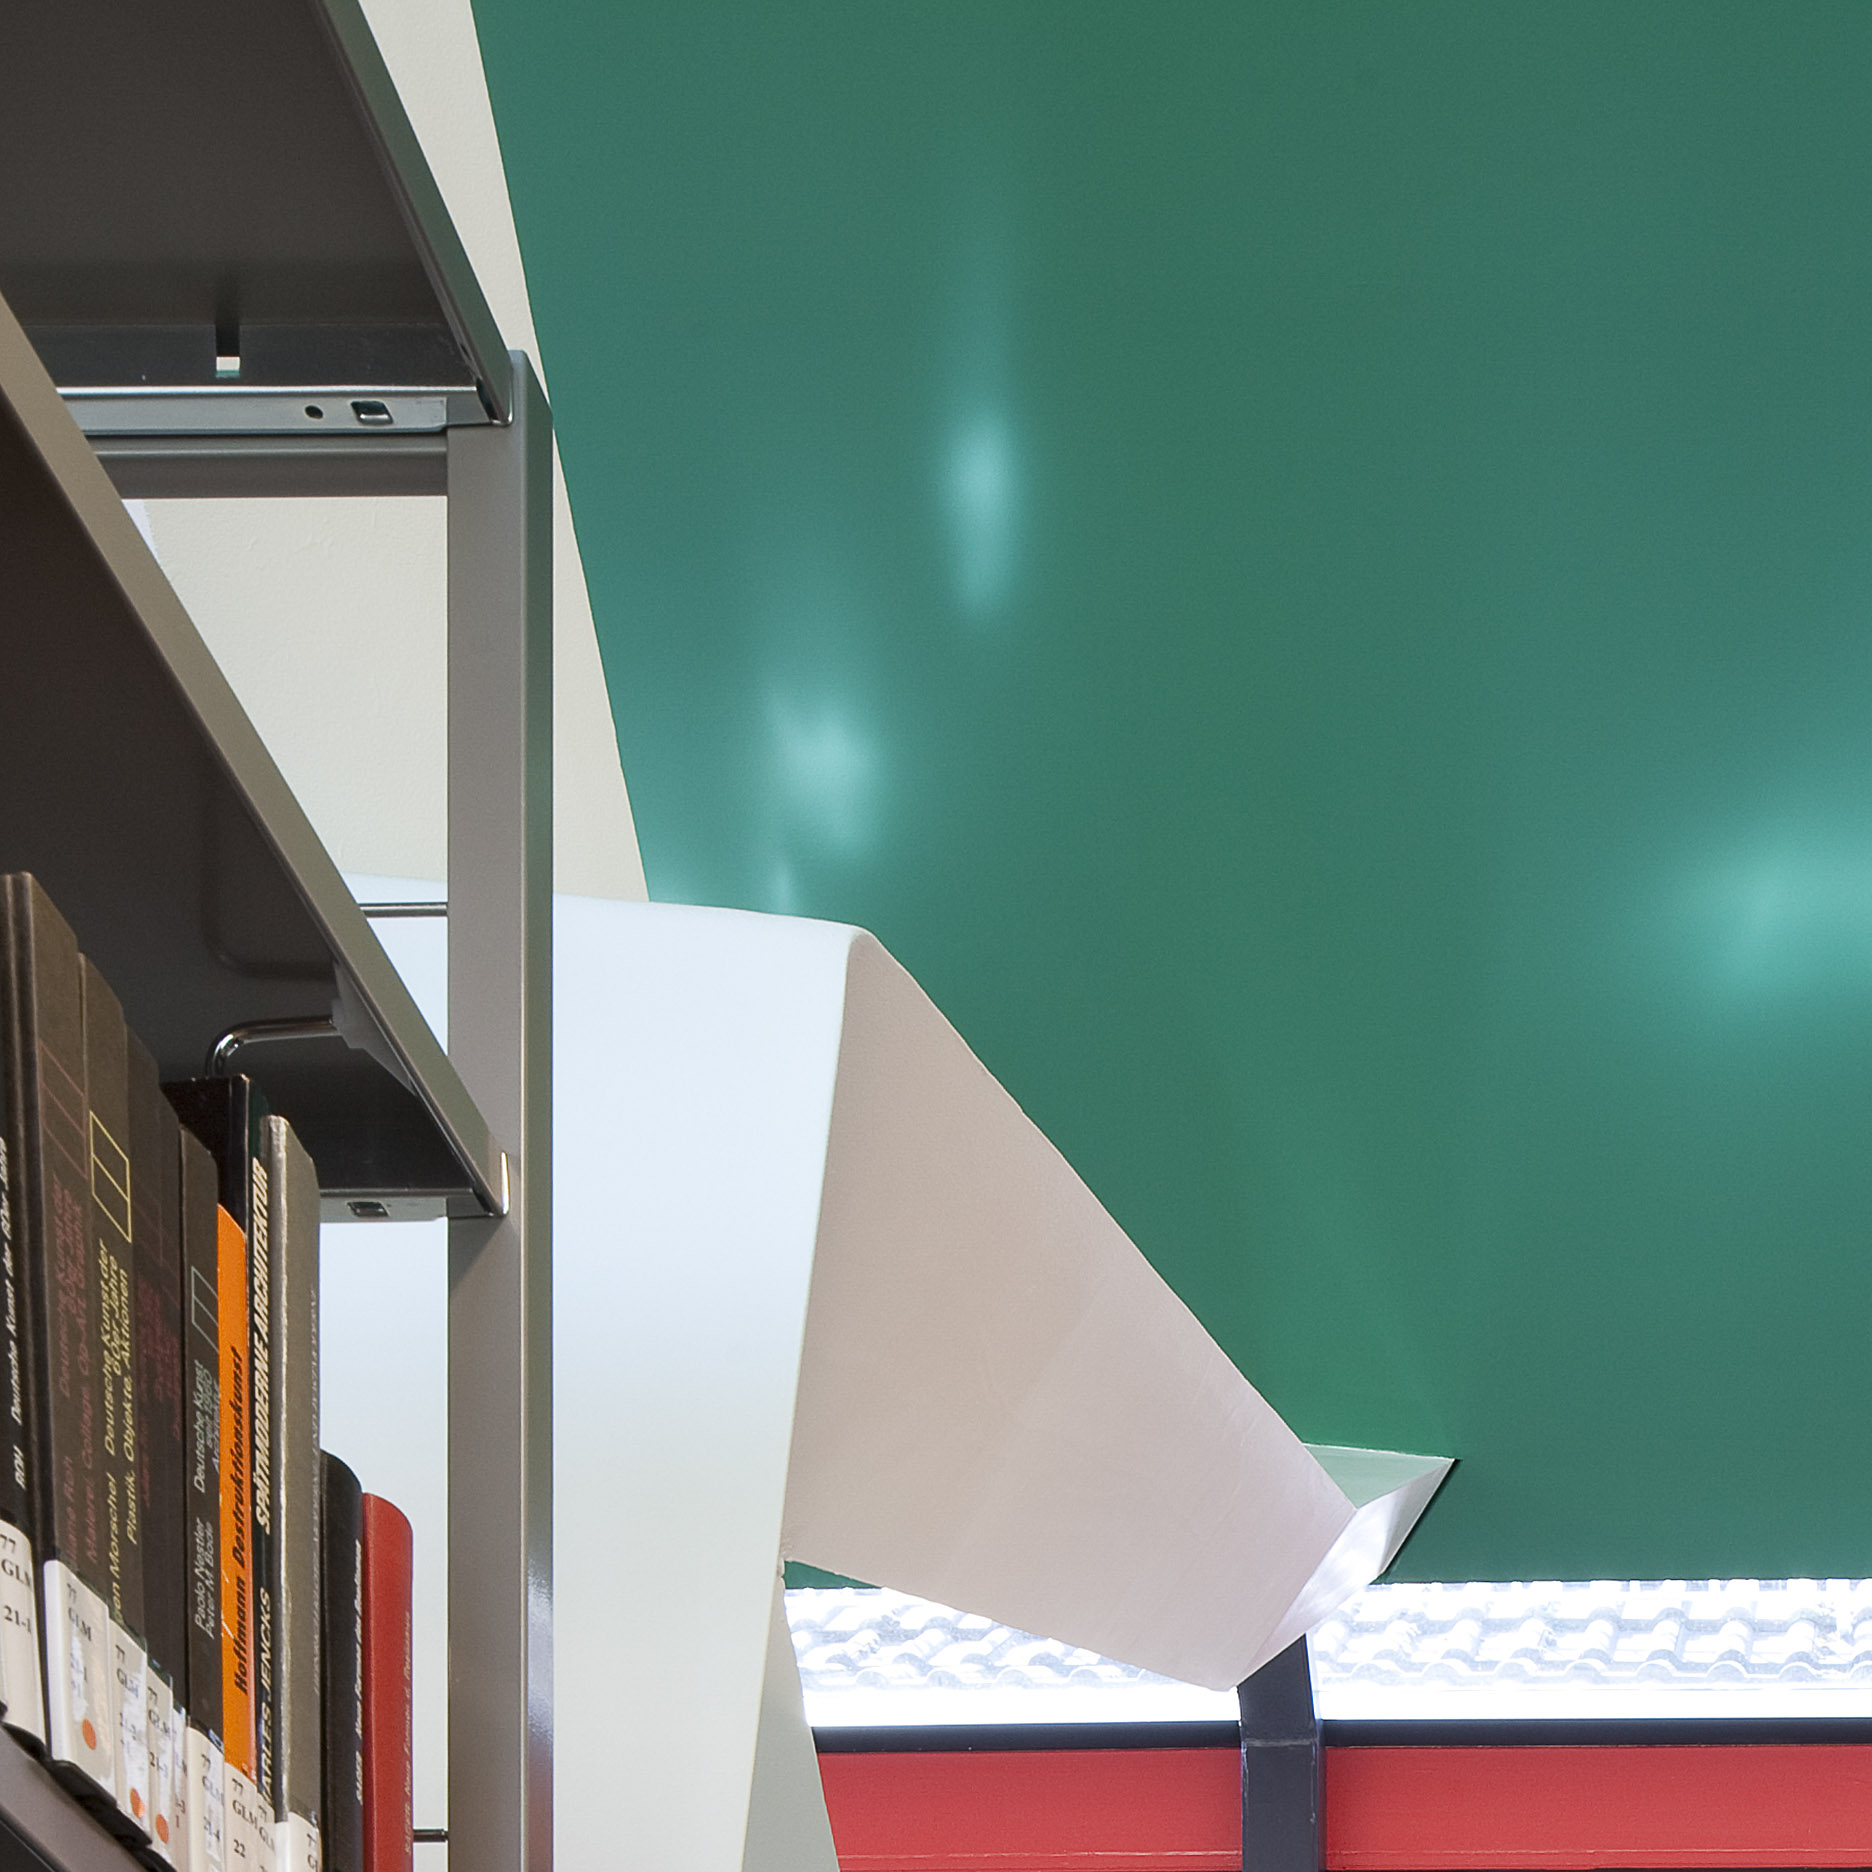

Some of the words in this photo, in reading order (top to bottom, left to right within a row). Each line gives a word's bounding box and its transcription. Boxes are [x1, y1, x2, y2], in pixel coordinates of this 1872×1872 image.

[4, 1243, 14, 1276] der
[98, 1239, 109, 1280] der
[252, 1156, 269, 1336] ARCHITEKTUR
[5, 1280, 16, 1337] Kunst
[119, 1268, 131, 1370] Aktionen
[8, 1342, 23, 1425] Deutsche
[102, 1355, 117, 1457] Deutsche
[192, 1359, 204, 1412] Kunst
[13, 1445, 26, 1489] ROH
[193, 1413, 207, 1494] Deutsche
[229, 1345, 247, 1571] Destruktionskunst
[251, 1337, 273, 1536] SPÄTMODERNE
[106, 1473, 121, 1579] Morschel
[234, 1576, 249, 1696] Hoffmann
[259, 1586, 273, 1702] JENCKS
[231, 1778, 245, 1797] 77
[233, 1840, 247, 1859] 22
